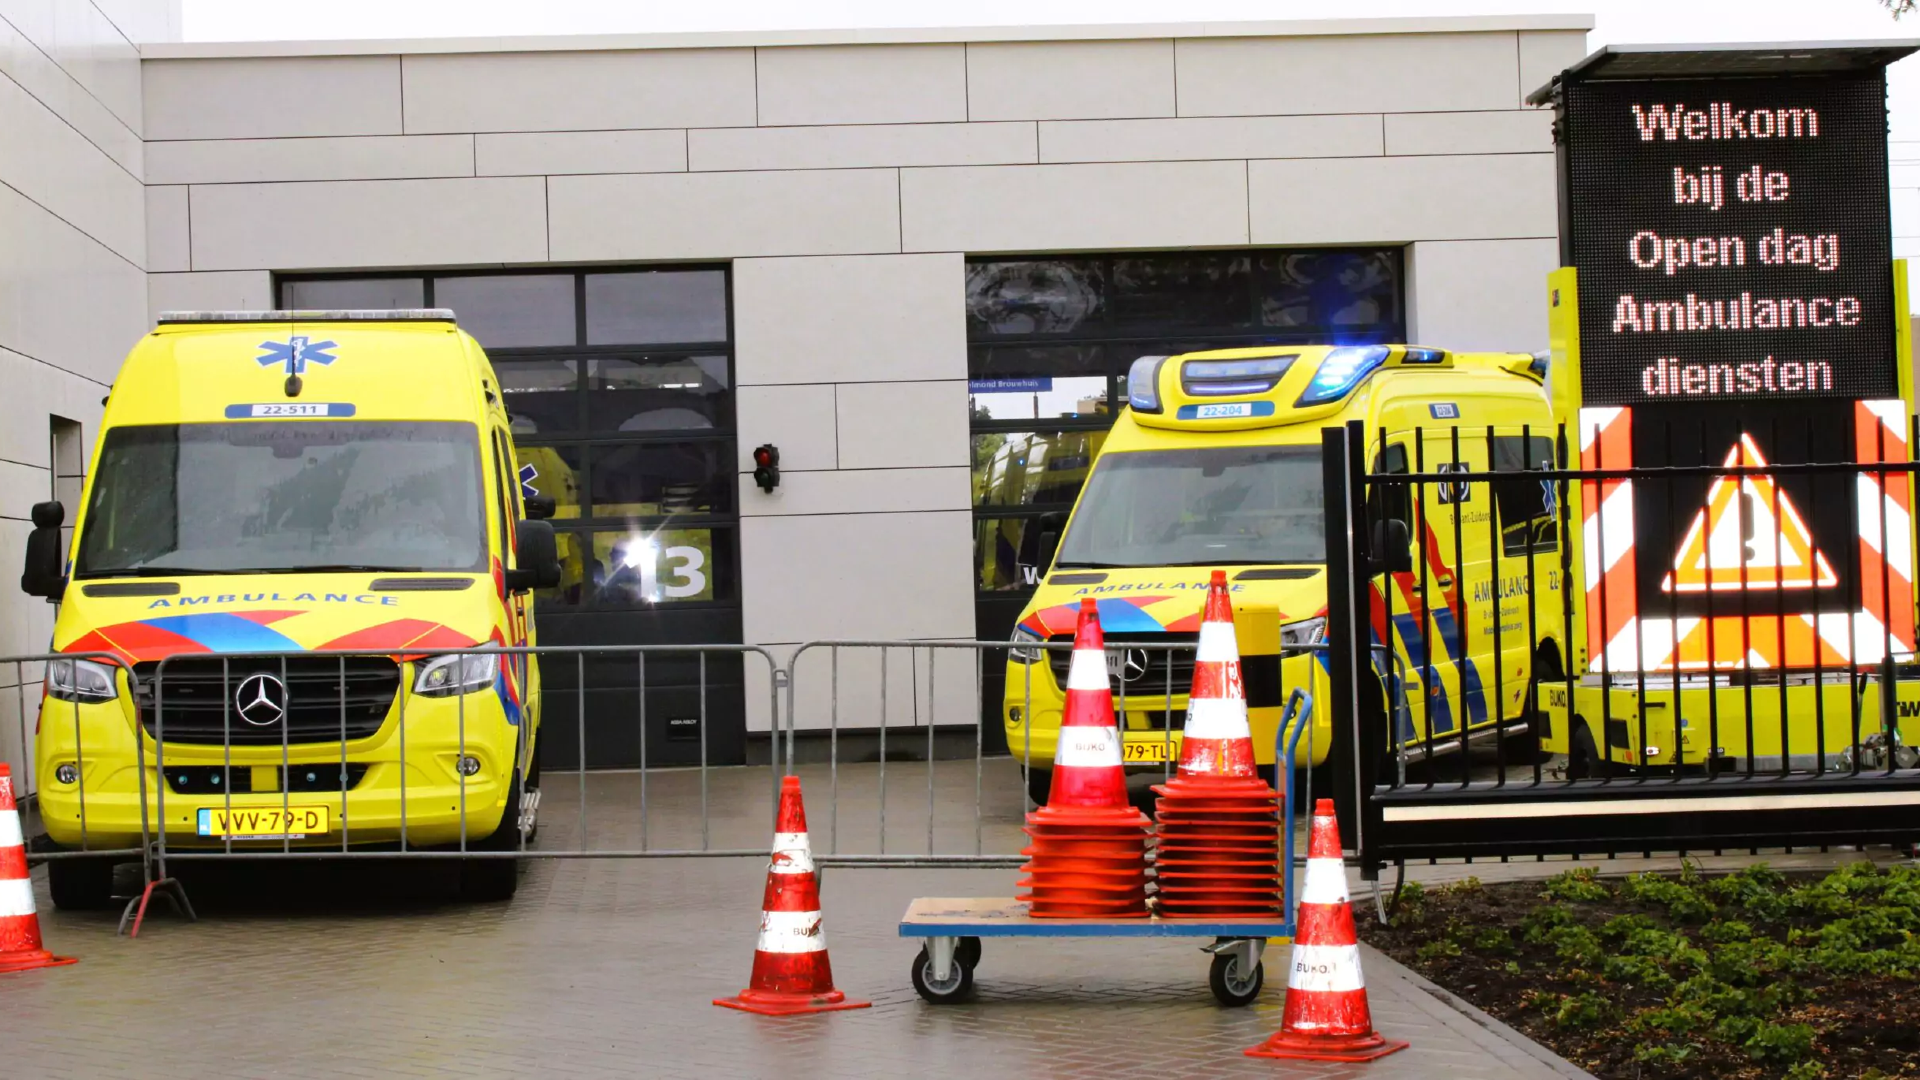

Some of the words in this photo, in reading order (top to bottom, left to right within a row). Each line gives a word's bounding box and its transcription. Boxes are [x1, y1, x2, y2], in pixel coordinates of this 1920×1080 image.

[1632, 102, 1819, 140] Welkom
[1673, 166, 1724, 210] bij
[1737, 165, 1789, 201] de
[1629, 231, 1746, 275] Open
[1758, 228, 1839, 271] dag
[1613, 292, 1862, 332] Ambulance
[969, 380, 996, 388] lmond
[998, 379, 1039, 388] Brouwhuis
[1642, 355, 1833, 395] diensten
[263, 405, 317, 415] 22-511
[1203, 405, 1243, 416] 22-204
[623, 545, 706, 598] 13
[147, 593, 399, 609] AMBULANCE
[1073, 582, 1248, 596] AMBULANE
[218, 810, 319, 831] VVV-79-D
